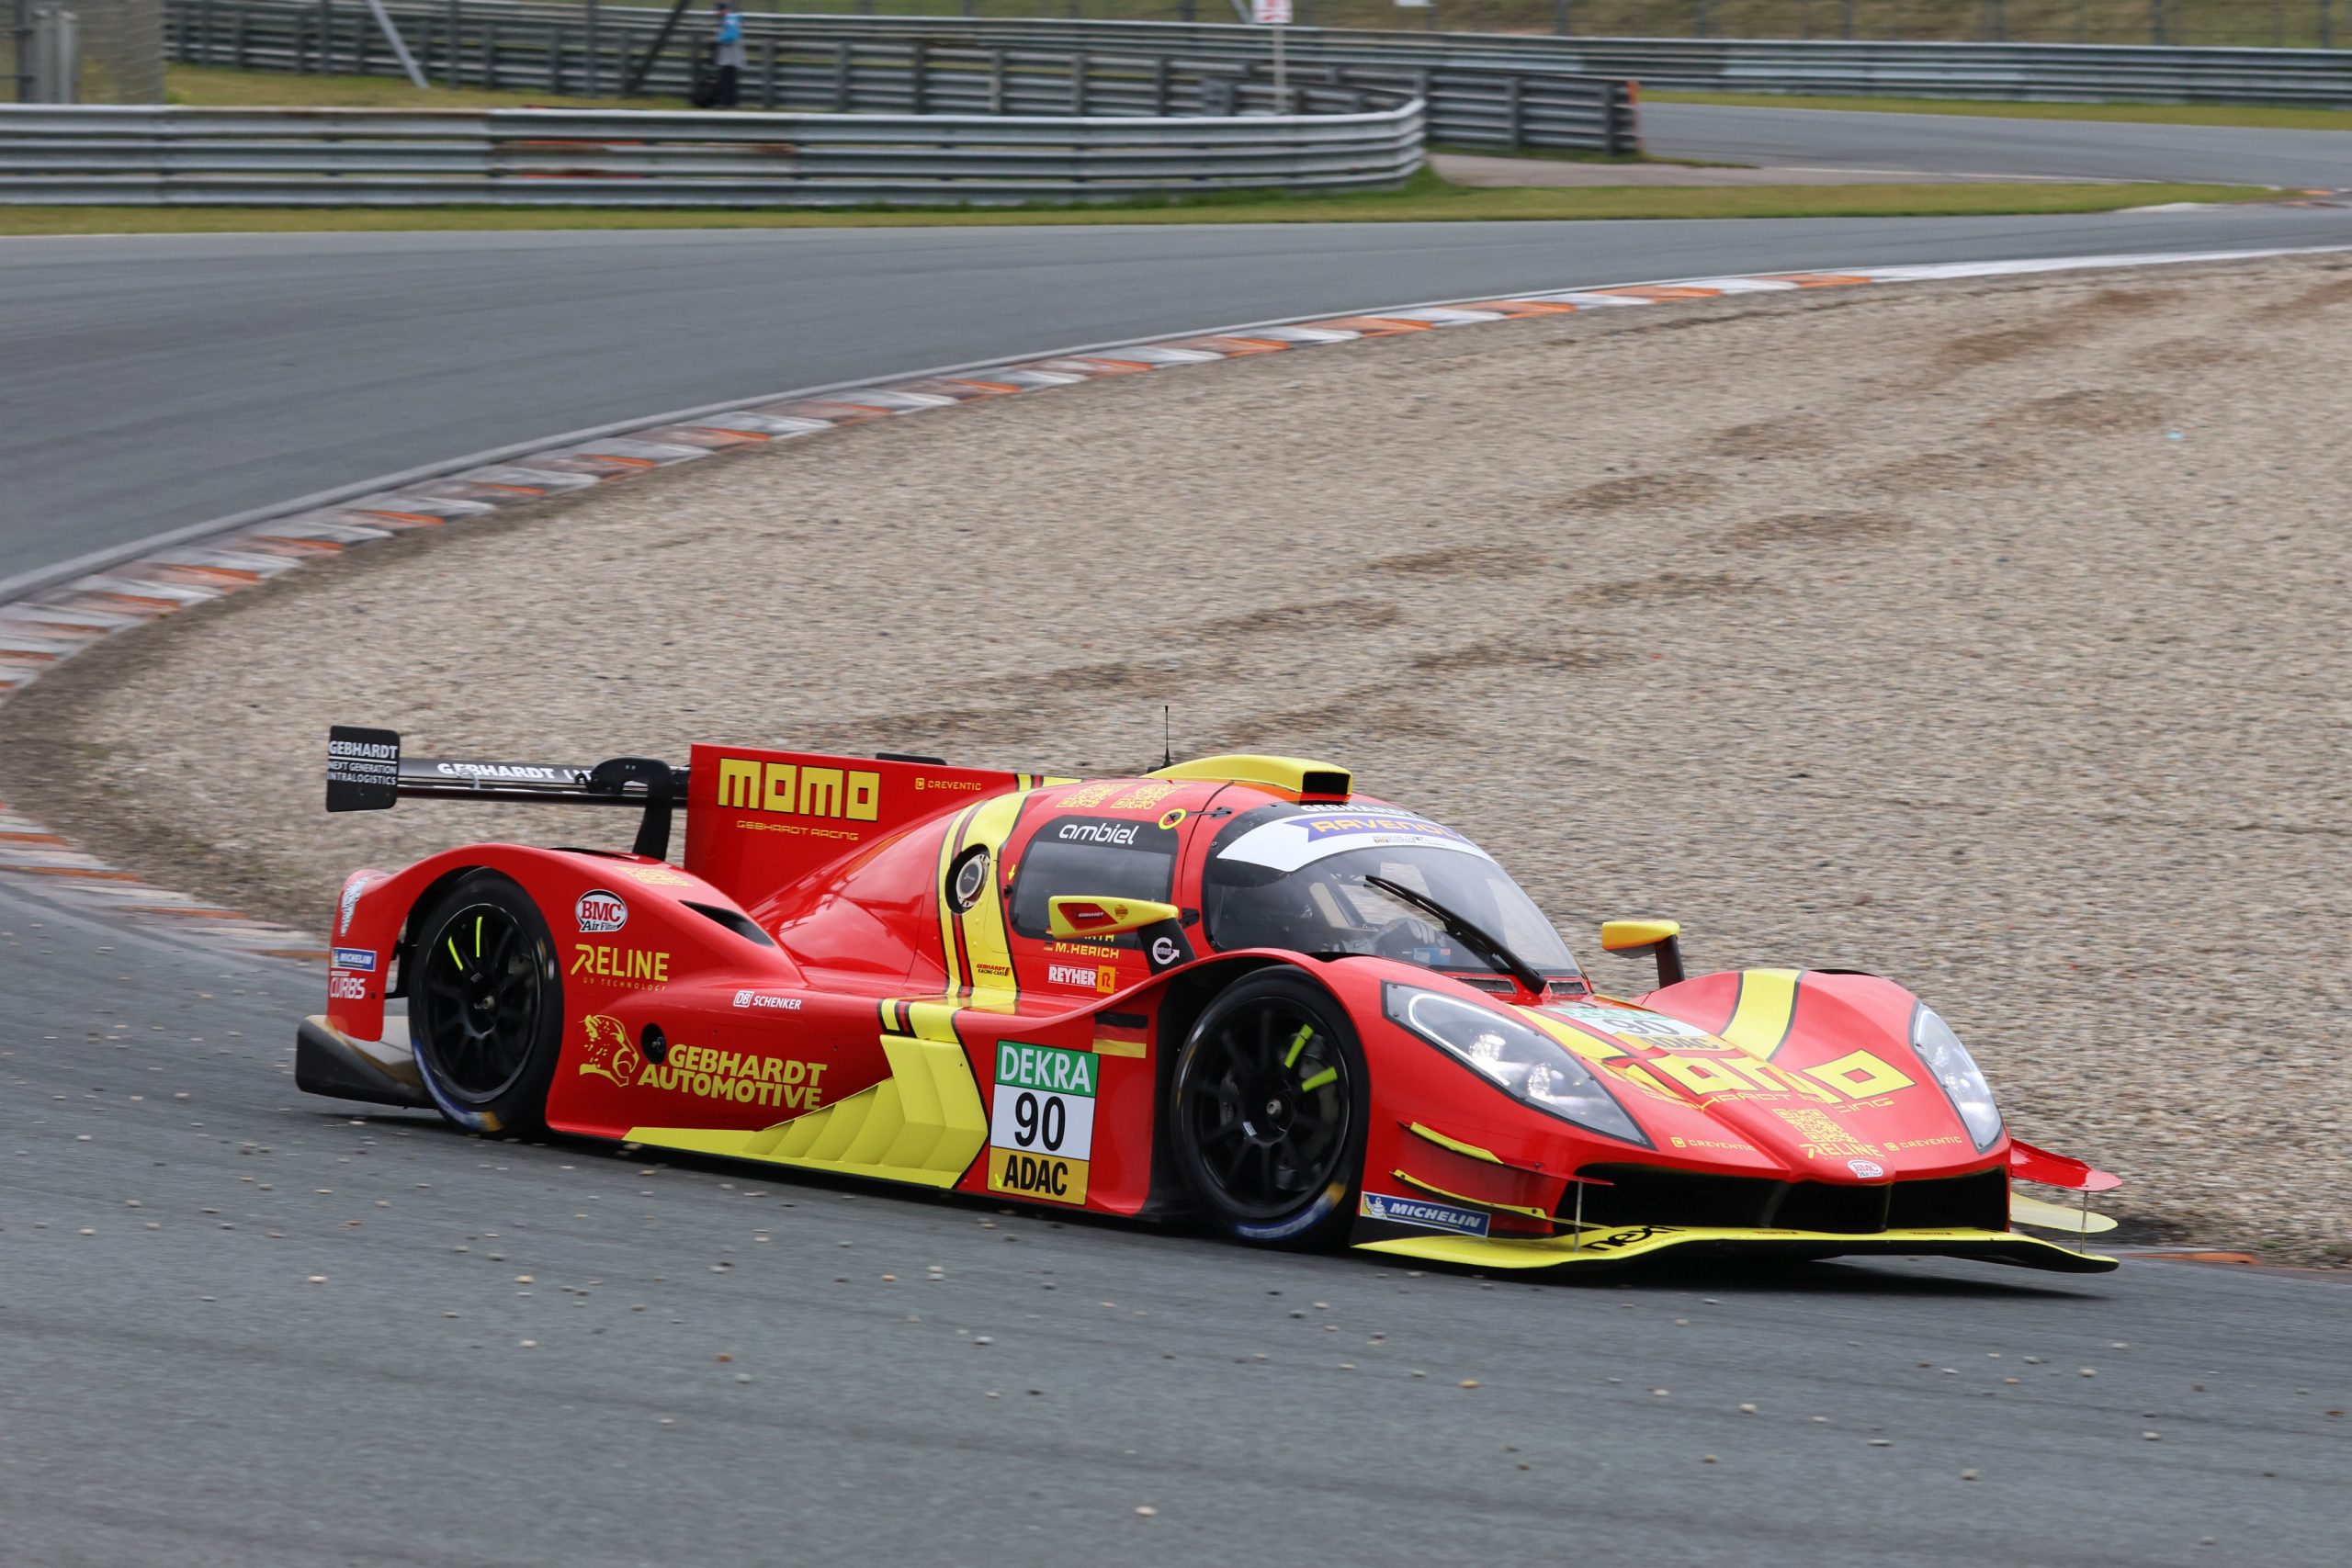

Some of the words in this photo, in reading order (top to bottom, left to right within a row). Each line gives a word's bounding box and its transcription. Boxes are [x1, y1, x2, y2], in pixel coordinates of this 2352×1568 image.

[329, 740, 398, 759] GEBHARDT
[349, 762, 397, 774] GENERATION
[437, 763, 555, 779] GEBHARDT
[327, 772, 397, 785] INTRALOGISTICS
[928, 780, 982, 791] CREVENTIC
[737, 820, 808, 835] GEBHARDT
[810, 829, 859, 841] RACING
[1058, 822, 1139, 845] ambiel
[1310, 818, 1459, 840] RAVENOL
[581, 900, 622, 923] BMC
[581, 919, 601, 931] Air
[570, 943, 670, 982] RELINE
[601, 978, 667, 992] TECHNOLOGY
[1048, 965, 1097, 987] REYHER
[736, 992, 751, 1005] DB
[752, 995, 802, 1010] SCHENKER
[1602, 1018, 1680, 1035] 90
[668, 1043, 828, 1087] GEBHARDT
[1000, 1045, 1091, 1093] DEKRA
[637, 1064, 822, 1111] AUTOMOTIVE
[1014, 1091, 1066, 1152] 90
[1688, 1138, 1756, 1152] CREVENTIC
[1798, 1143, 1886, 1159] RELINE
[1899, 1136, 1962, 1148] CREVENTIC
[1002, 1155, 1069, 1196] ADAC
[1390, 1202, 1482, 1228] MICHELIN
